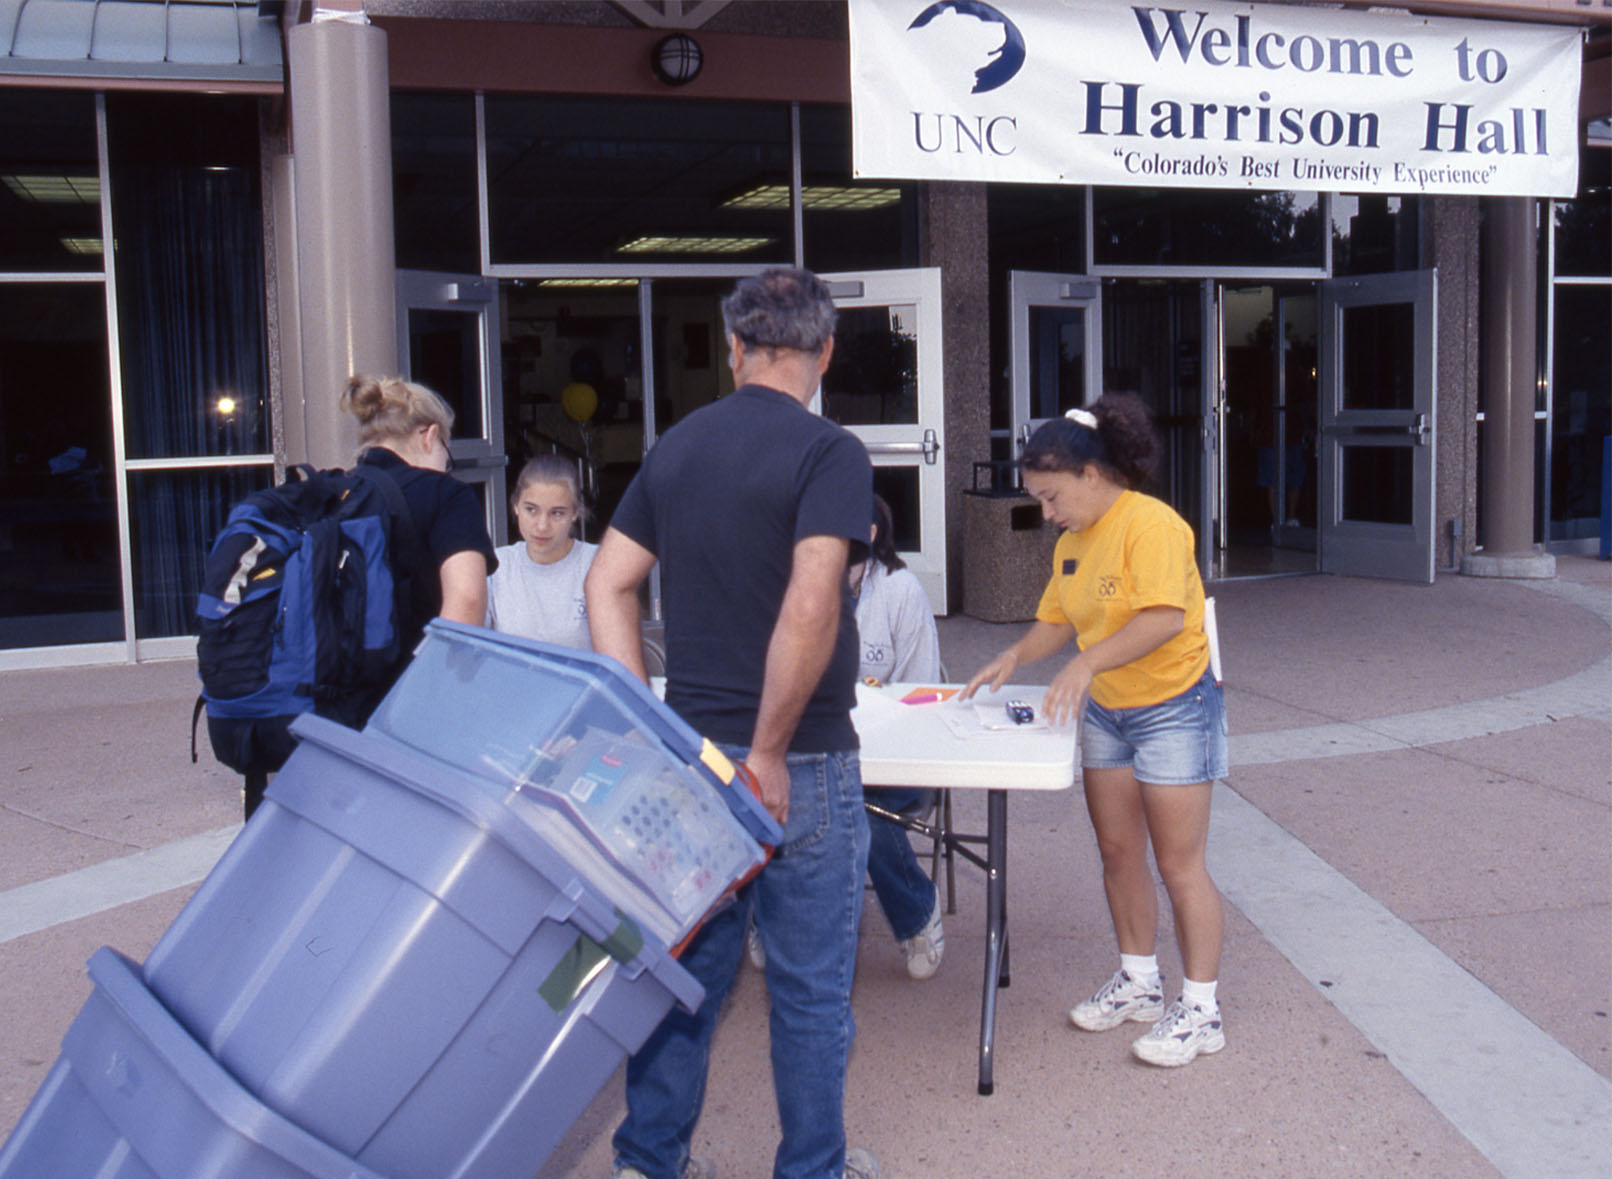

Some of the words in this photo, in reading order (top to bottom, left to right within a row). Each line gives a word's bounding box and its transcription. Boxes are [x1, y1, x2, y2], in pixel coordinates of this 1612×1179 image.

[1131, 5, 1413, 78] Welcome
[1454, 36, 1508, 84] to
[911, 111, 1017, 156] UNC
[1078, 80, 1380, 149] Harrison
[1419, 101, 1549, 156] Hall
[1241, 155, 1281, 179] Best
[1292, 158, 1382, 186] University
